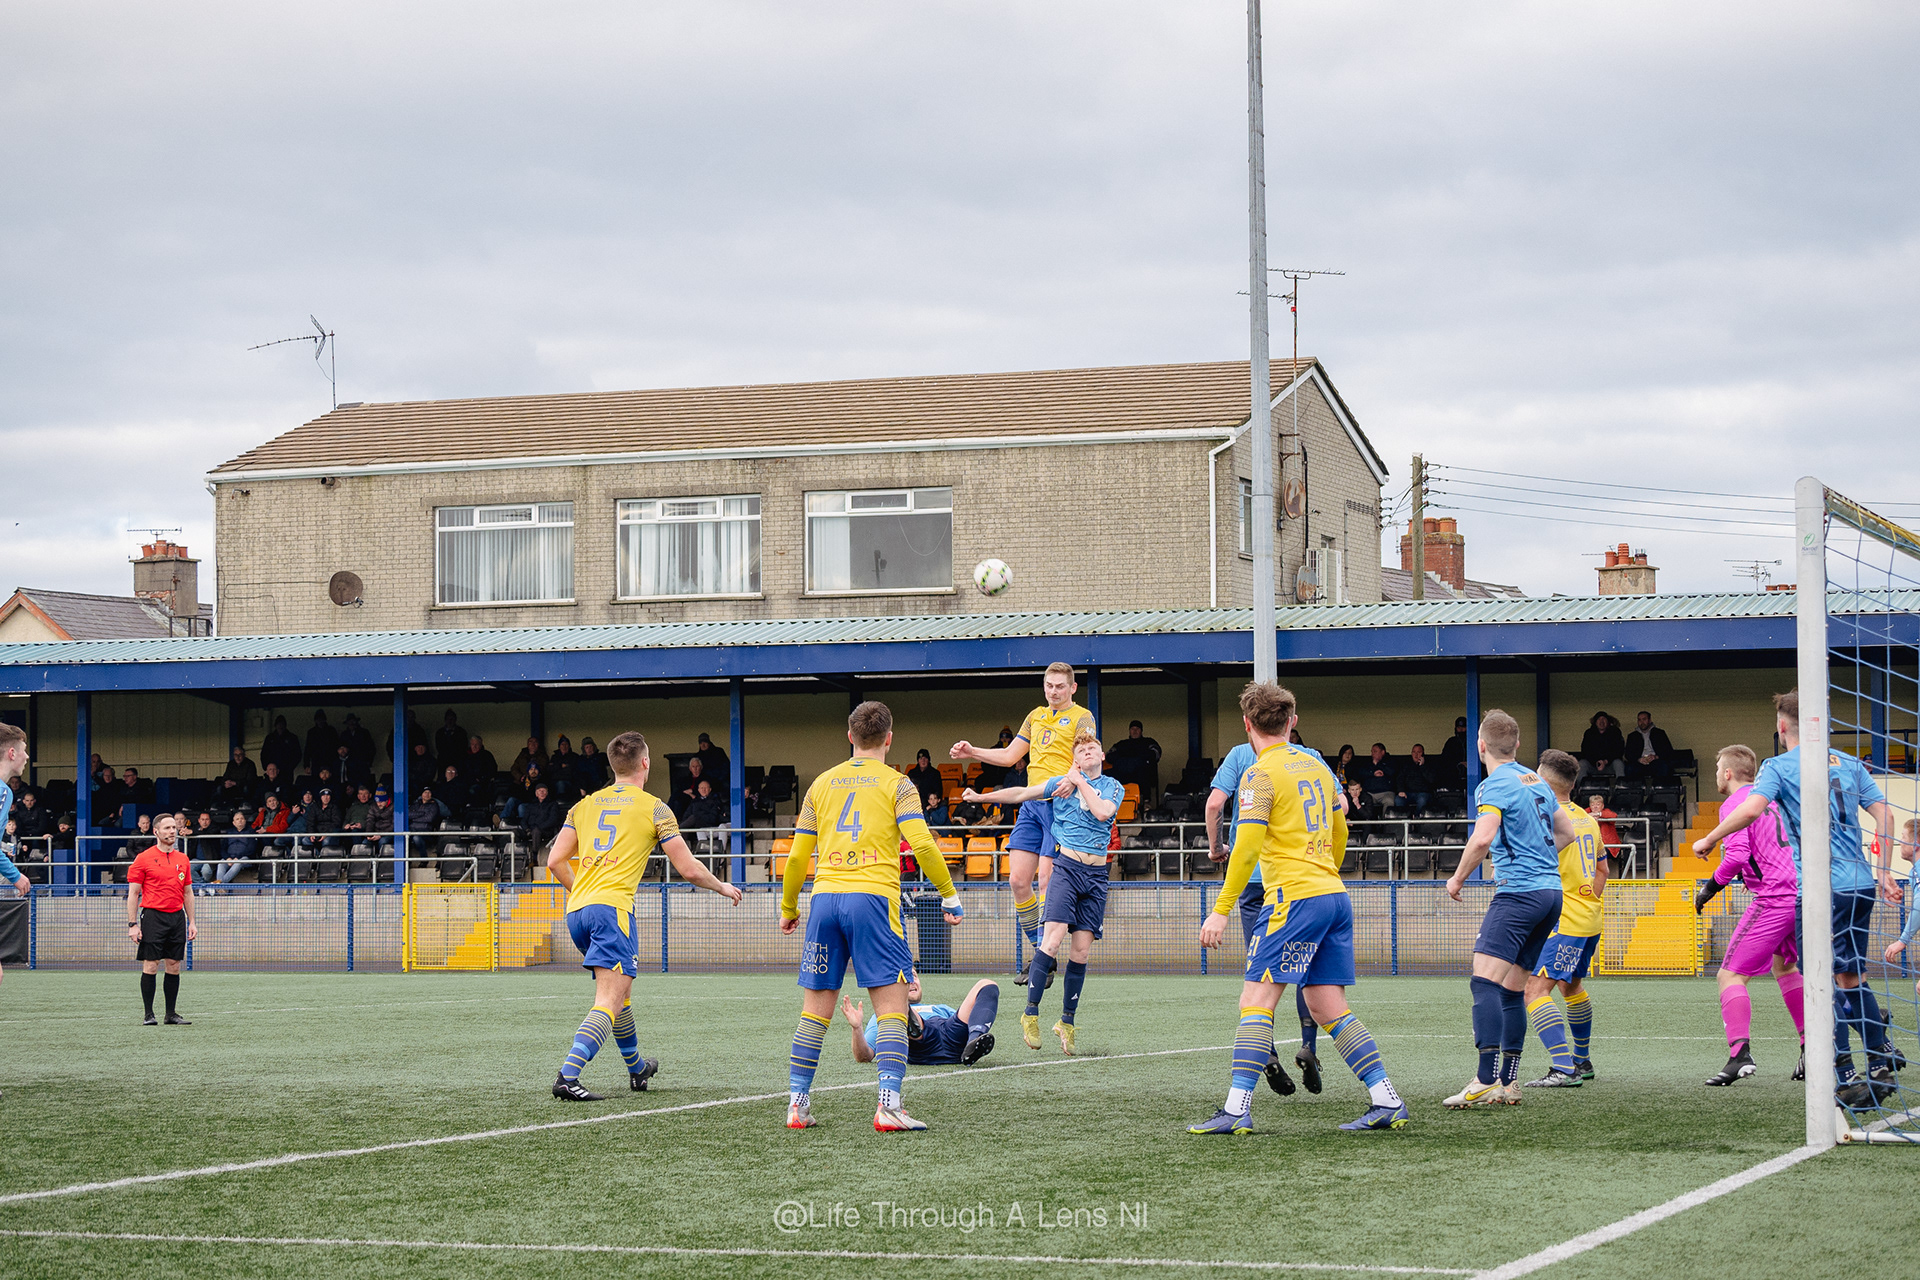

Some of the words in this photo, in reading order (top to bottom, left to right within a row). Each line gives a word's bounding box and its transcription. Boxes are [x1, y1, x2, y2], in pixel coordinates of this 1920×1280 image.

[830, 775, 880, 786] eventsec
[836, 791, 863, 842] 4
[1297, 778, 1328, 832] 21
[1534, 796, 1554, 847] 5
[593, 809, 621, 851] 5
[1575, 833, 1596, 878] 19
[1281, 951, 1314, 963] DOW
[1555, 952, 1580, 966] DOW
[1557, 943, 1583, 957] NORT
